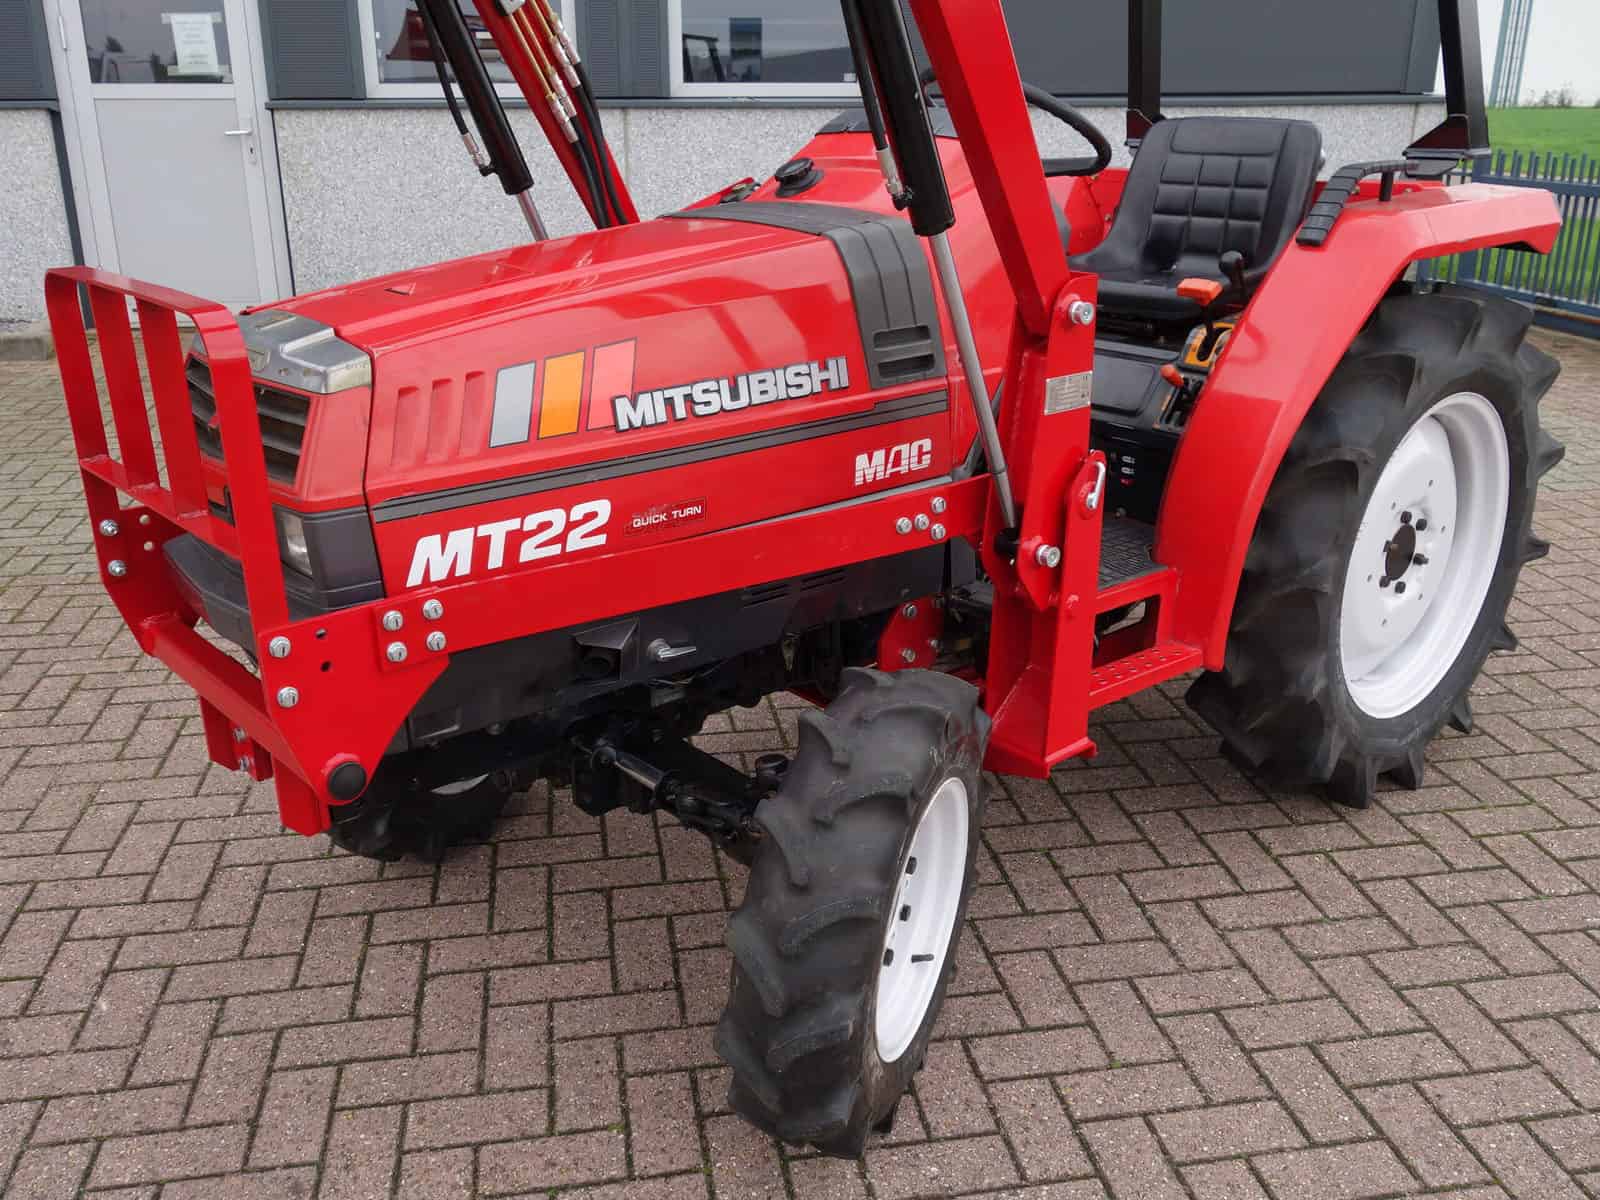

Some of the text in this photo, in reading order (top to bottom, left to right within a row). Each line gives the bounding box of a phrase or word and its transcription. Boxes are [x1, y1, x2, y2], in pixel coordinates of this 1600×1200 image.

[613, 355, 849, 432] MITSUBISHI
[855, 438, 932, 485] MAC
[406, 499, 612, 588] MT22
[632, 505, 702, 528] QUICK TURN
